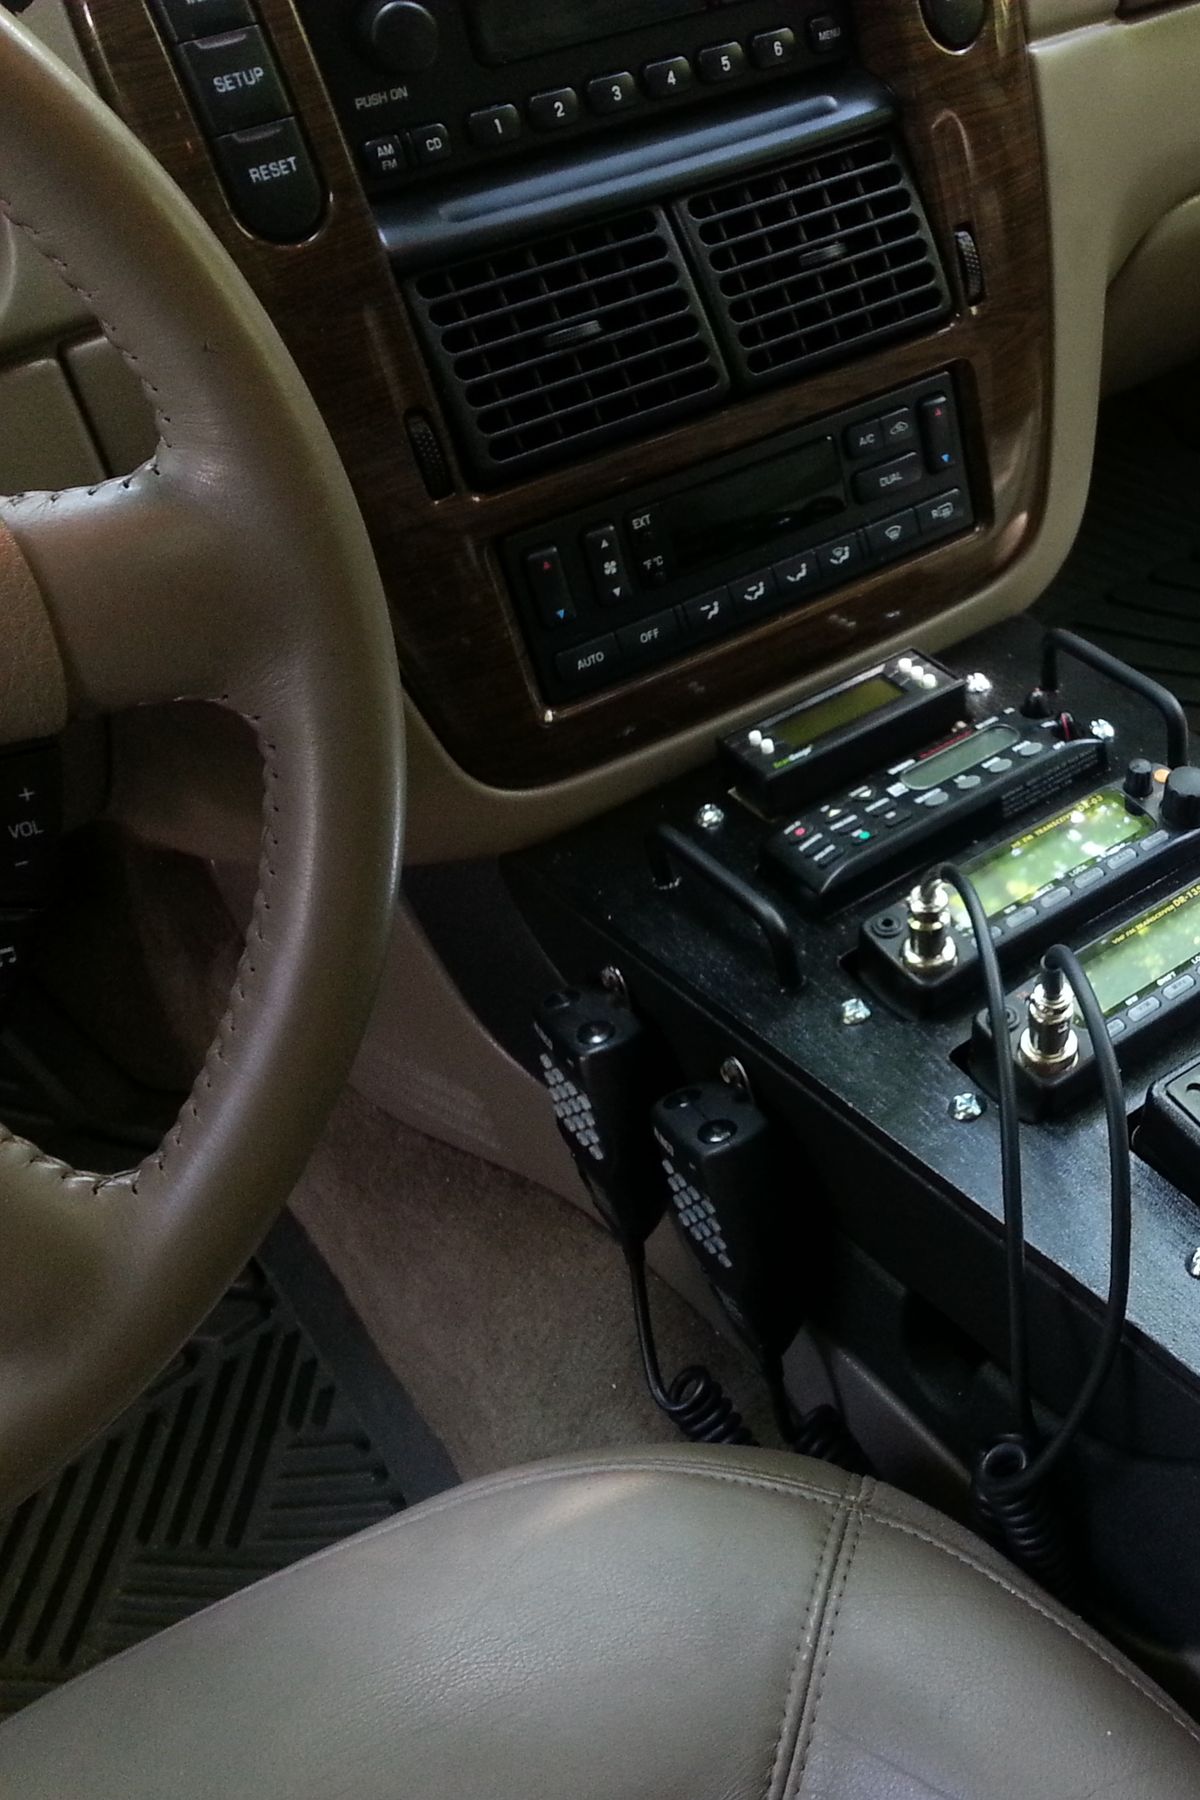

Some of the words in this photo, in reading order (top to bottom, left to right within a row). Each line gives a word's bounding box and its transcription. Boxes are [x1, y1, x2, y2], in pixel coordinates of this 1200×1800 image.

[773, 40, 784, 57] 6
[720, 55, 731, 72] 5
[213, 66, 265, 93] SETUP
[667, 70, 676, 86] 4
[355, 90, 387, 110] PUSH
[390, 86, 409, 101] ON
[611, 85, 622, 101] 3
[553, 101, 565, 118] 2
[493, 118, 503, 134] 1
[377, 143, 395, 158] AM
[425, 137, 443, 151] CD
[249, 156, 297, 183] RESET
[382, 158, 398, 171] FM
[879, 472, 904, 488] DUAL
[632, 514, 651, 531] EXT
[639, 627, 660, 644] OFF
[577, 651, 605, 671] AUTO
[8, 820, 44, 839] VOL
[1069, 865, 1088, 877] LOCK
